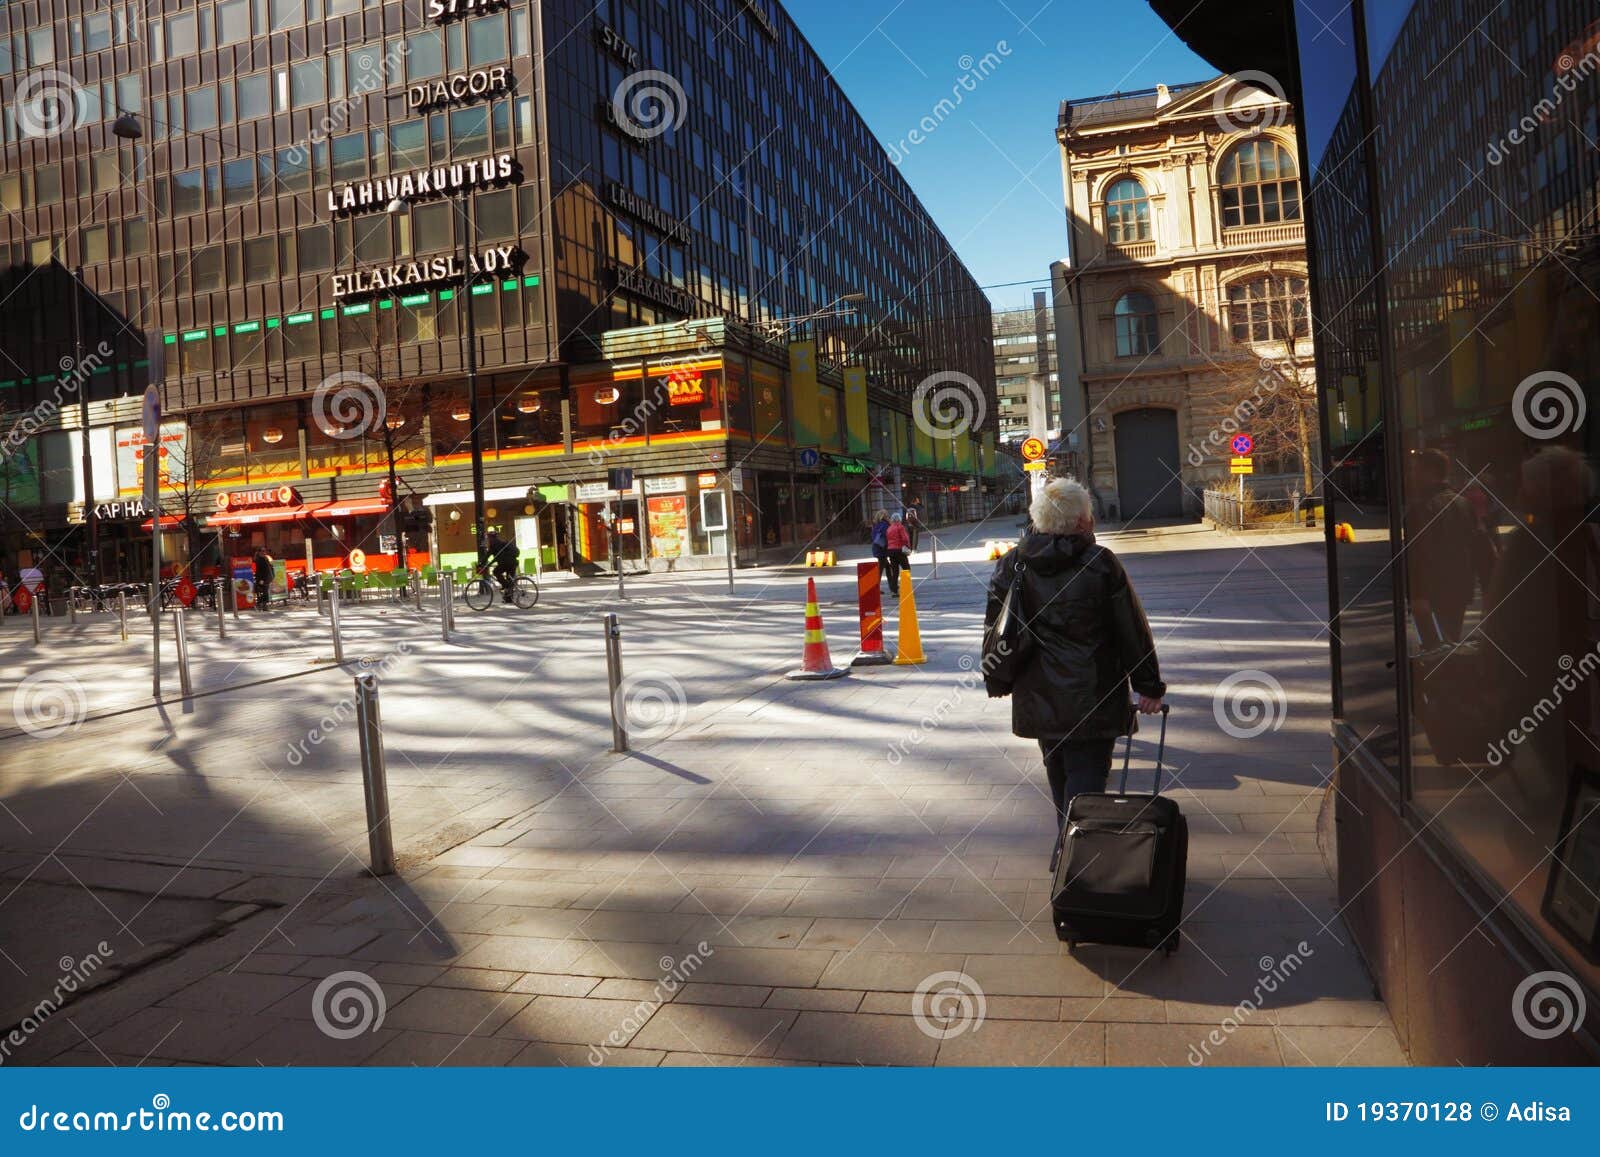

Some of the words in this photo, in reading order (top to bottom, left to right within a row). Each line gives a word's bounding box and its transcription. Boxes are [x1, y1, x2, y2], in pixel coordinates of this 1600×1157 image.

[603, 26, 638, 67] STTK
[408, 67, 507, 108] DIACOR
[328, 154, 512, 211] LÄHIVAKUUTUS
[668, 379, 704, 398] RAX
